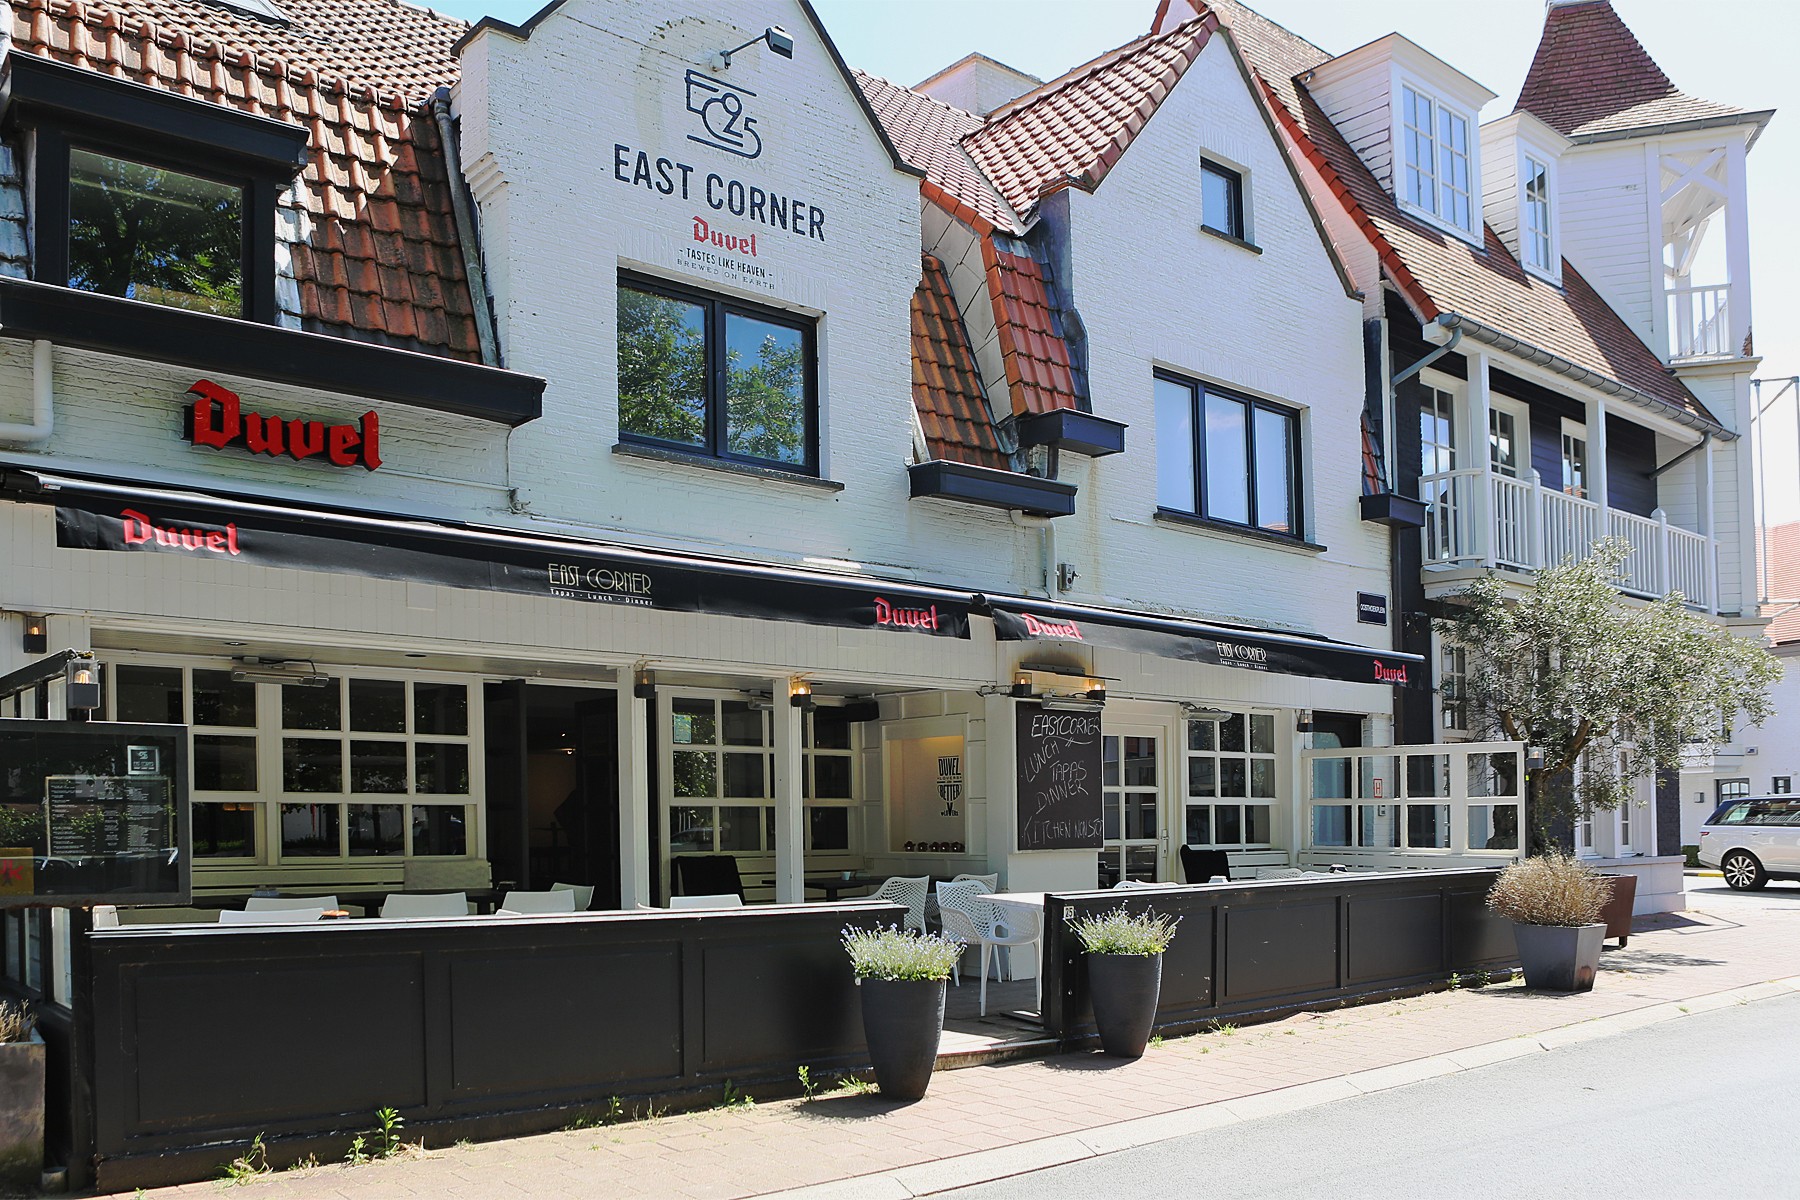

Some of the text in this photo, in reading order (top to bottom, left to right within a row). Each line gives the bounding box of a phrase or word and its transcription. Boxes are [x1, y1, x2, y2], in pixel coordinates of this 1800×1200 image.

[614, 143, 694, 200] EAST
[706, 173, 825, 242] CORNER
[692, 215, 757, 257] Duvel
[677, 258, 775, 290] BREWED ON EARTH
[686, 247, 766, 278] TASTES LIKE HEAVEN
[183, 378, 384, 473] Duvel
[120, 508, 241, 556] Duvel
[548, 563, 652, 595] EAST CORNER
[550, 588, 653, 606] Tapas Lunch Dinner
[873, 596, 938, 631] Duvel
[1021, 612, 1083, 640] Duvel
[1235, 644, 1267, 662] CORNER
[1373, 659, 1408, 683] Duvel
[937, 757, 962, 776] DUVEL
[1023, 740, 1060, 783] LUNCH
[1049, 760, 1088, 783] TAPAS
[938, 784, 961, 802] BETTER
[1035, 779, 1089, 815] DINNER
[1022, 815, 1072, 848] KITCHEN
